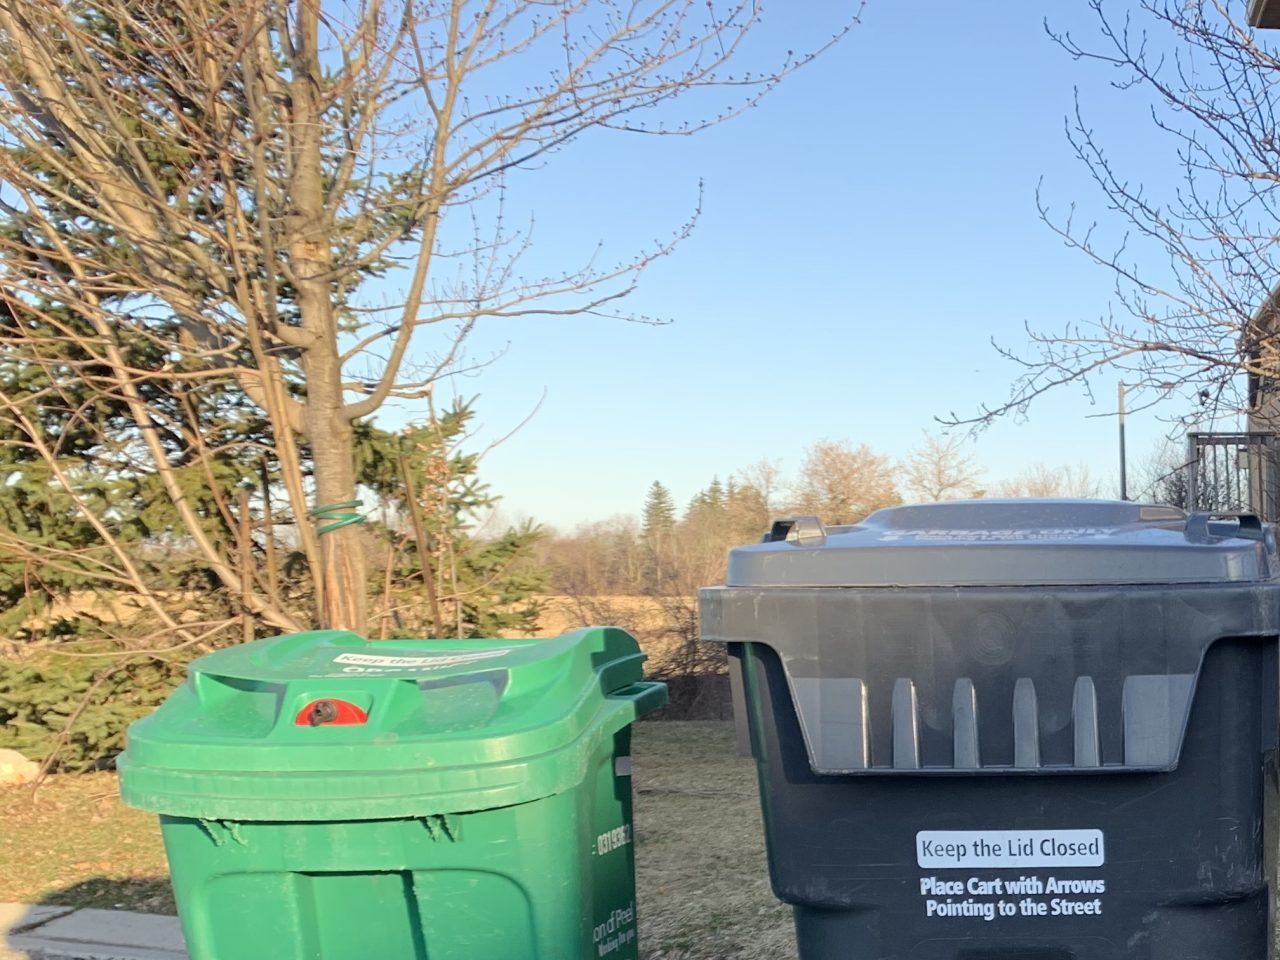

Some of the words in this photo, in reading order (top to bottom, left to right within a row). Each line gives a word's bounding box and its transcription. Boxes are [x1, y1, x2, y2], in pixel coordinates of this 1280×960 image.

[341, 654, 384, 665] Keep
[389, 656, 417, 665] the
[922, 840, 968, 862] Keep
[972, 839, 1002, 857] the
[1008, 838, 1034, 857] Lid
[1040, 838, 1100, 856] Closed
[919, 876, 964, 896] Place
[966, 877, 1003, 896] Cart
[1004, 876, 1044, 895] with
[1044, 876, 1106, 895] Arrows
[926, 899, 996, 921] Pointing
[997, 900, 1017, 917] to
[1019, 898, 1048, 916] the
[1051, 898, 1102, 916] Street
